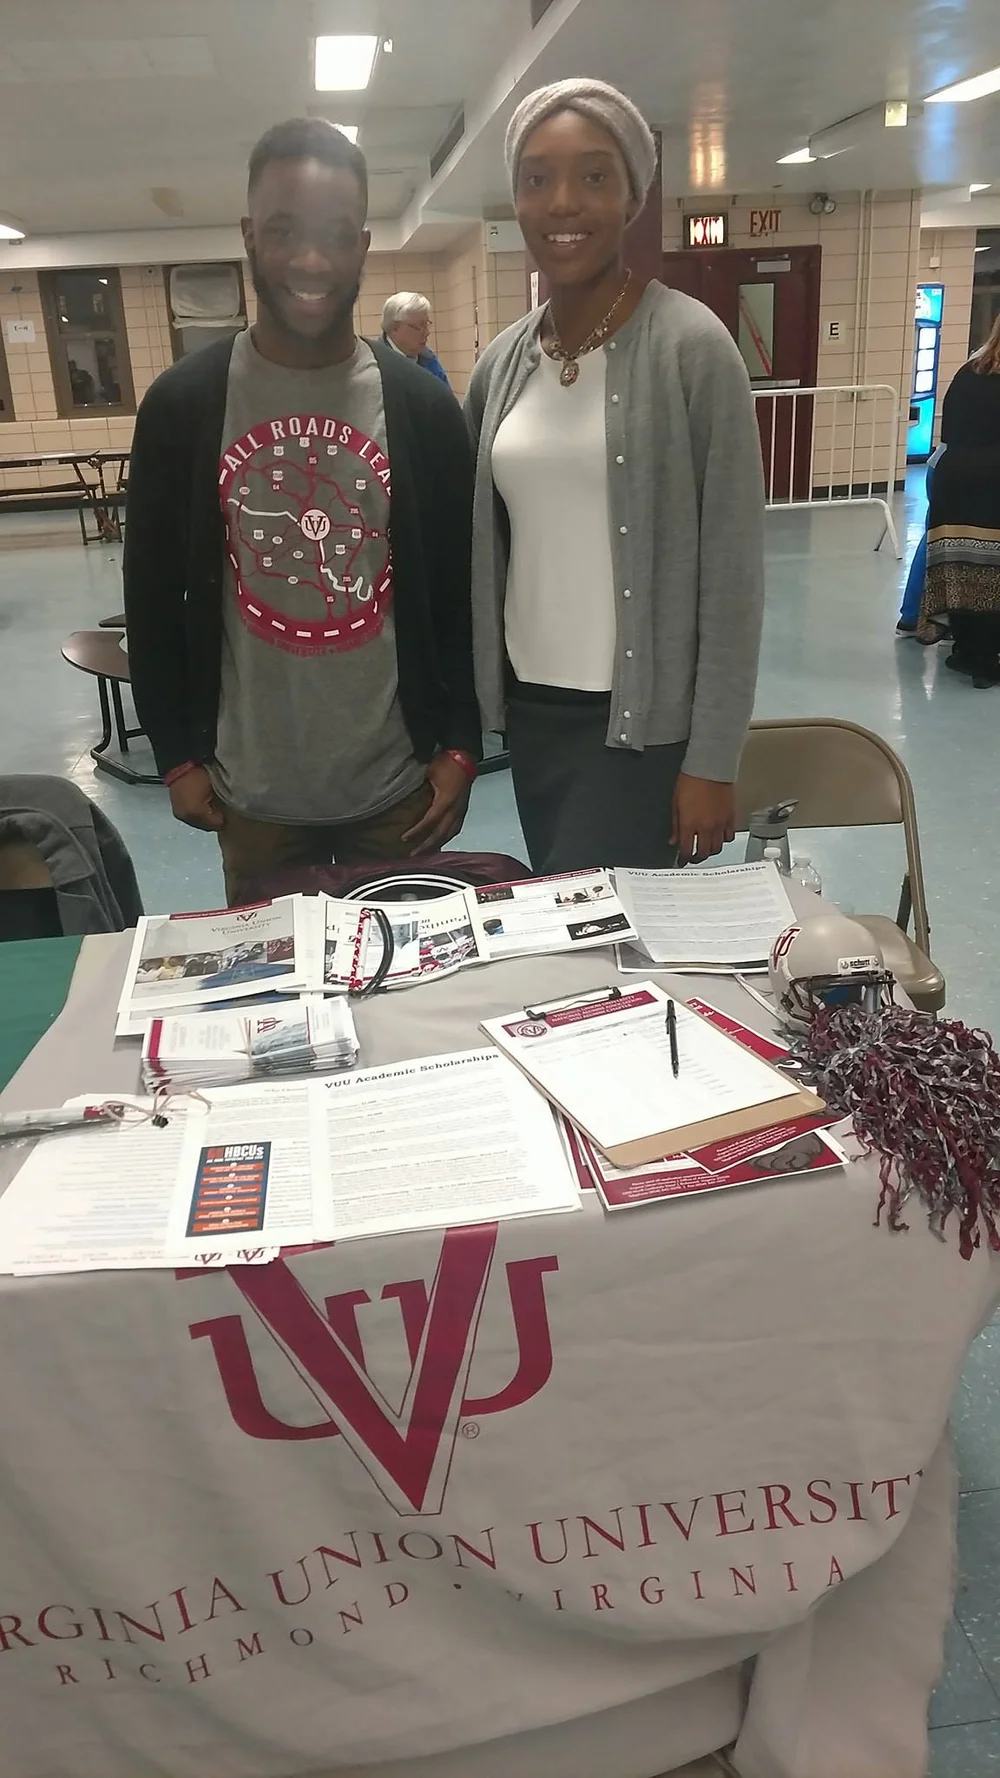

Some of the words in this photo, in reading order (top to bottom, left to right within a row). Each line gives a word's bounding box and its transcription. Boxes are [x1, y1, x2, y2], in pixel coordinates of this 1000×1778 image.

[750, 210, 781, 233] EXIT
[830, 322, 839, 335] E
[225, 433, 263, 472] ALL
[271, 417, 352, 444] ROADS
[358, 440, 391, 496] LEA
[652, 868, 700, 878] Academic
[702, 865, 767, 877] Scholarships
[324, 1079, 351, 1090] VUU
[355, 1068, 416, 1084] Academic
[420, 1053, 500, 1073] Scholarships
[266, 1527, 498, 1606] UNION
[525, 1468, 924, 1565] UNIVERSIT
[56, 1582, 409, 1685] RICHMOND
